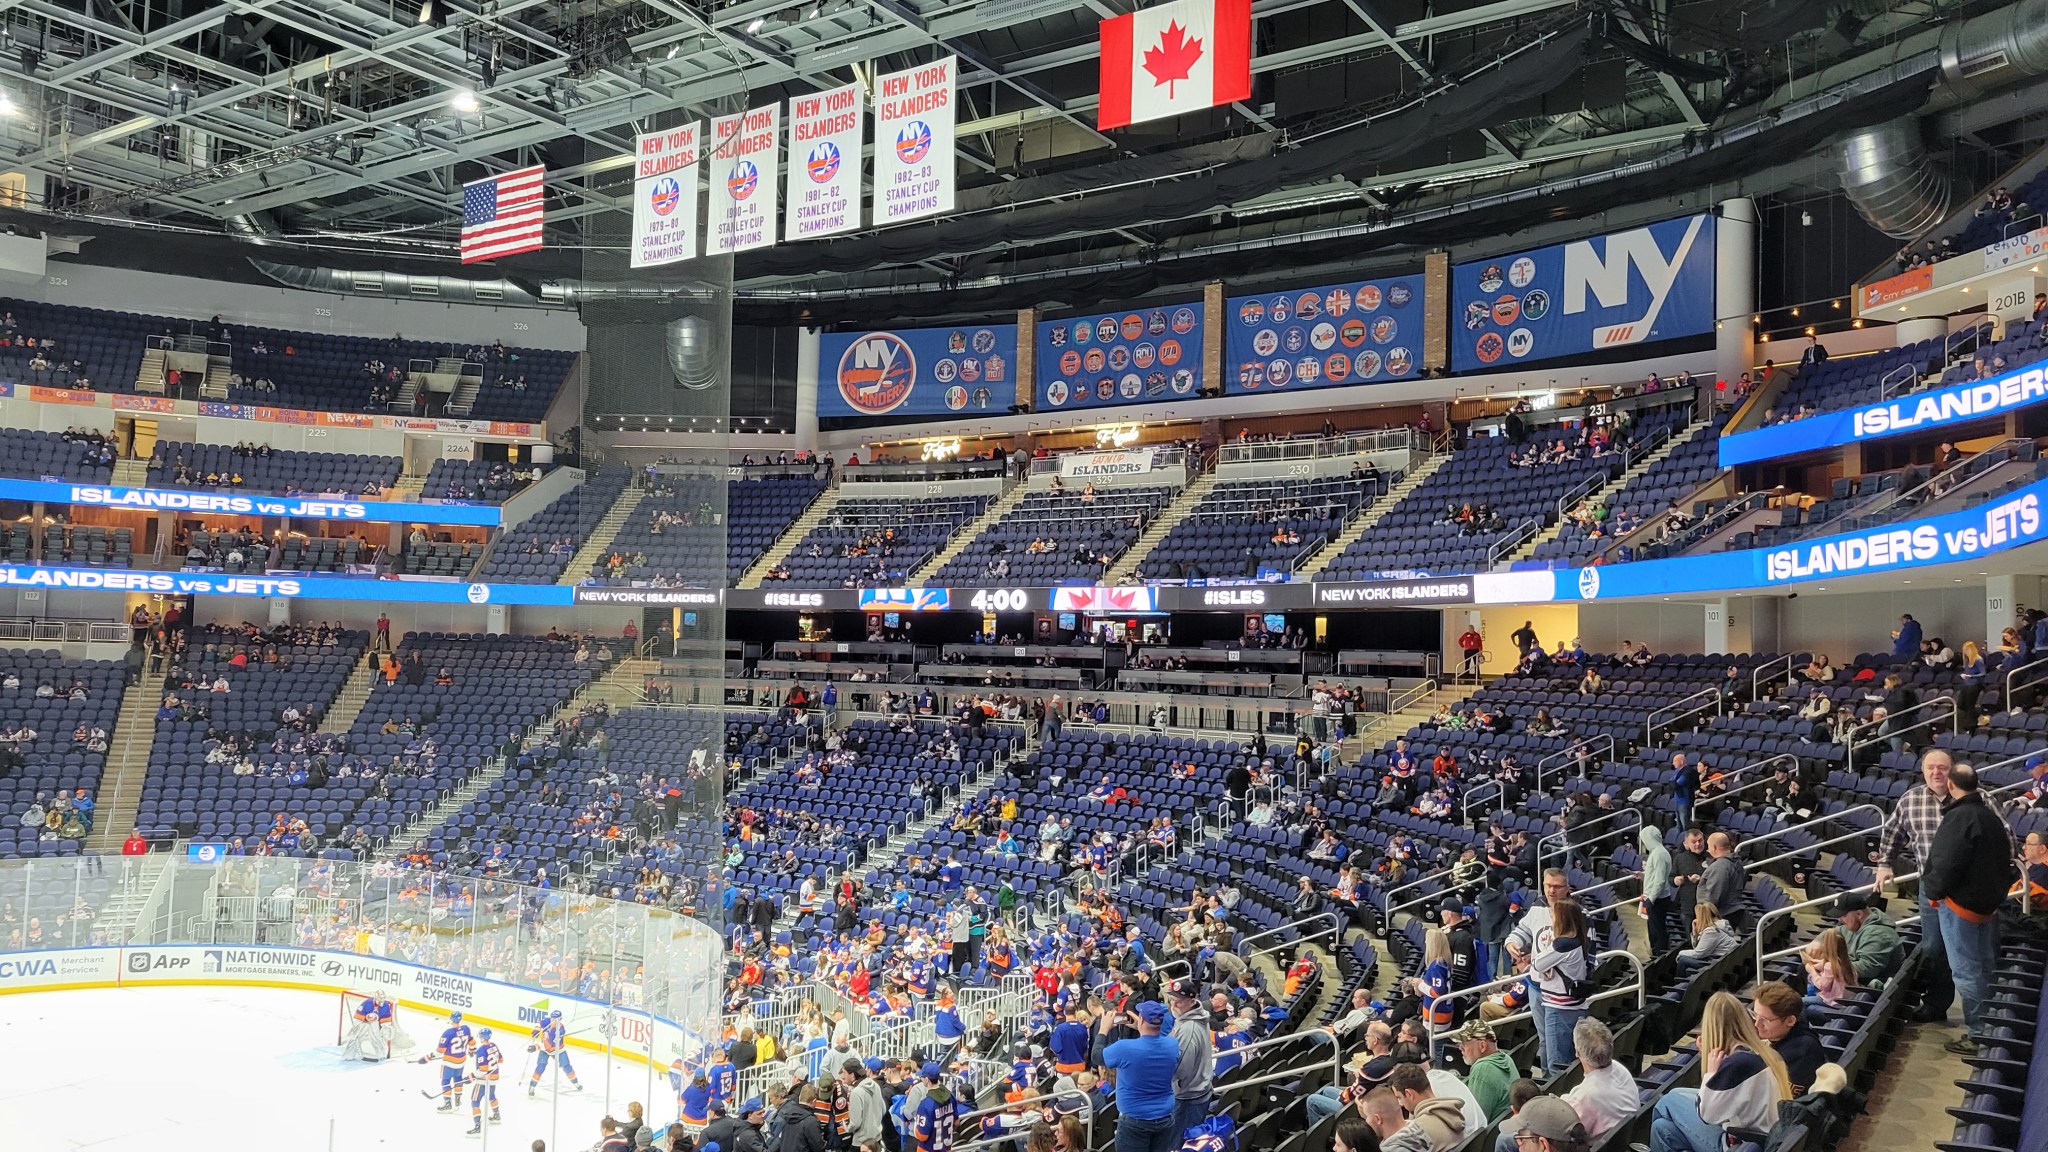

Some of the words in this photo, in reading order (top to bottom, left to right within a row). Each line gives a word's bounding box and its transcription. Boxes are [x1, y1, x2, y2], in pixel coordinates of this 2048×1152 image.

[883, 76, 909, 98] NEW
[914, 64, 948, 90] YORK
[796, 99, 821, 119] NEW
[826, 88, 856, 112] YORK
[881, 88, 948, 121] ISLANDERS
[717, 120, 740, 138] NEW
[744, 110, 772, 130] YORK
[795, 112, 856, 142] ISLANDERS
[642, 138, 664, 155] NEW
[668, 128, 693, 150] YORK
[716, 132, 772, 160] ISLANDERS
[640, 150, 694, 176] ISLANDERS
[886, 184, 922, 202] STANLEY
[924, 179, 940, 192] CUP
[798, 201, 832, 219] STANLEY
[832, 198, 848, 212] CUP
[888, 196, 938, 216] CHAMPIONS
[718, 220, 750, 234] STANLEY
[750, 216, 764, 228] CUP
[799, 215, 844, 233] CHAMPIONS
[642, 234, 672, 248] STANLEY
[672, 230, 686, 242] CUP
[720, 232, 762, 249] CHAMPIONS
[644, 245, 683, 260] CHAMPIONS
[49, 276, 68, 286] 324
[1564, 215, 1705, 335] NY
[1883, 292, 1898, 302] CITY
[1901, 286, 1920, 296] CREW
[1996, 291, 2026, 311] 201B
[315, 308, 332, 317] 325
[513, 322, 528, 331] 326
[855, 340, 900, 370] NY
[846, 379, 906, 407] ISLANDERS
[1590, 404, 1606, 416] 231
[1854, 367, 2048, 437] ISLANDER
[394, 419, 408, 428] NY
[308, 428, 327, 437] 225
[447, 444, 470, 453] 226A
[1114, 454, 1125, 462] UP
[1072, 464, 1142, 476] ISLANDERS
[1289, 464, 1310, 475] 230
[1096, 476, 1113, 484] 329
[927, 485, 942, 494] 228
[72, 488, 252, 512] ISLANDERS
[290, 502, 367, 518] JETS
[1768, 525, 1939, 580] ISLANDERS
[1980, 494, 2039, 547] JETS
[216, 578, 300, 596] JETS
[1322, 589, 1356, 600] NEW
[1356, 587, 1390, 600] YORK
[1392, 584, 1468, 598] ISLANDERS
[580, 592, 611, 602] NEW
[611, 592, 646, 602] YORK
[646, 593, 716, 604] ISLANDERS
[764, 593, 822, 606] #ISLES
[970, 589, 1028, 610] 4:00
[1204, 590, 1265, 605] #ISLES
[1988, 598, 2002, 610] 101
[1708, 612, 1719, 622] 101
[2016, 603, 2024, 618] 101
[838, 644, 848, 652] 119
[1016, 648, 1025, 656] 120
[62, 956, 104, 964] Merchant
[226, 950, 316, 967] NATIONWIDE
[1454, 954, 1466, 966] 15
[0, 958, 57, 978] CWA
[60, 966, 98, 974] Services
[268, 968, 300, 976] BANKERS,
[348, 964, 402, 986] HYUNDAI
[415, 970, 473, 994] AMERICAN
[1432, 978, 1442, 988] 13
[422, 986, 473, 1008] EXPRESS
[450, 1036, 468, 1054] 27
[916, 1115, 926, 1126] 13
[933, 1114, 954, 1150] 13
